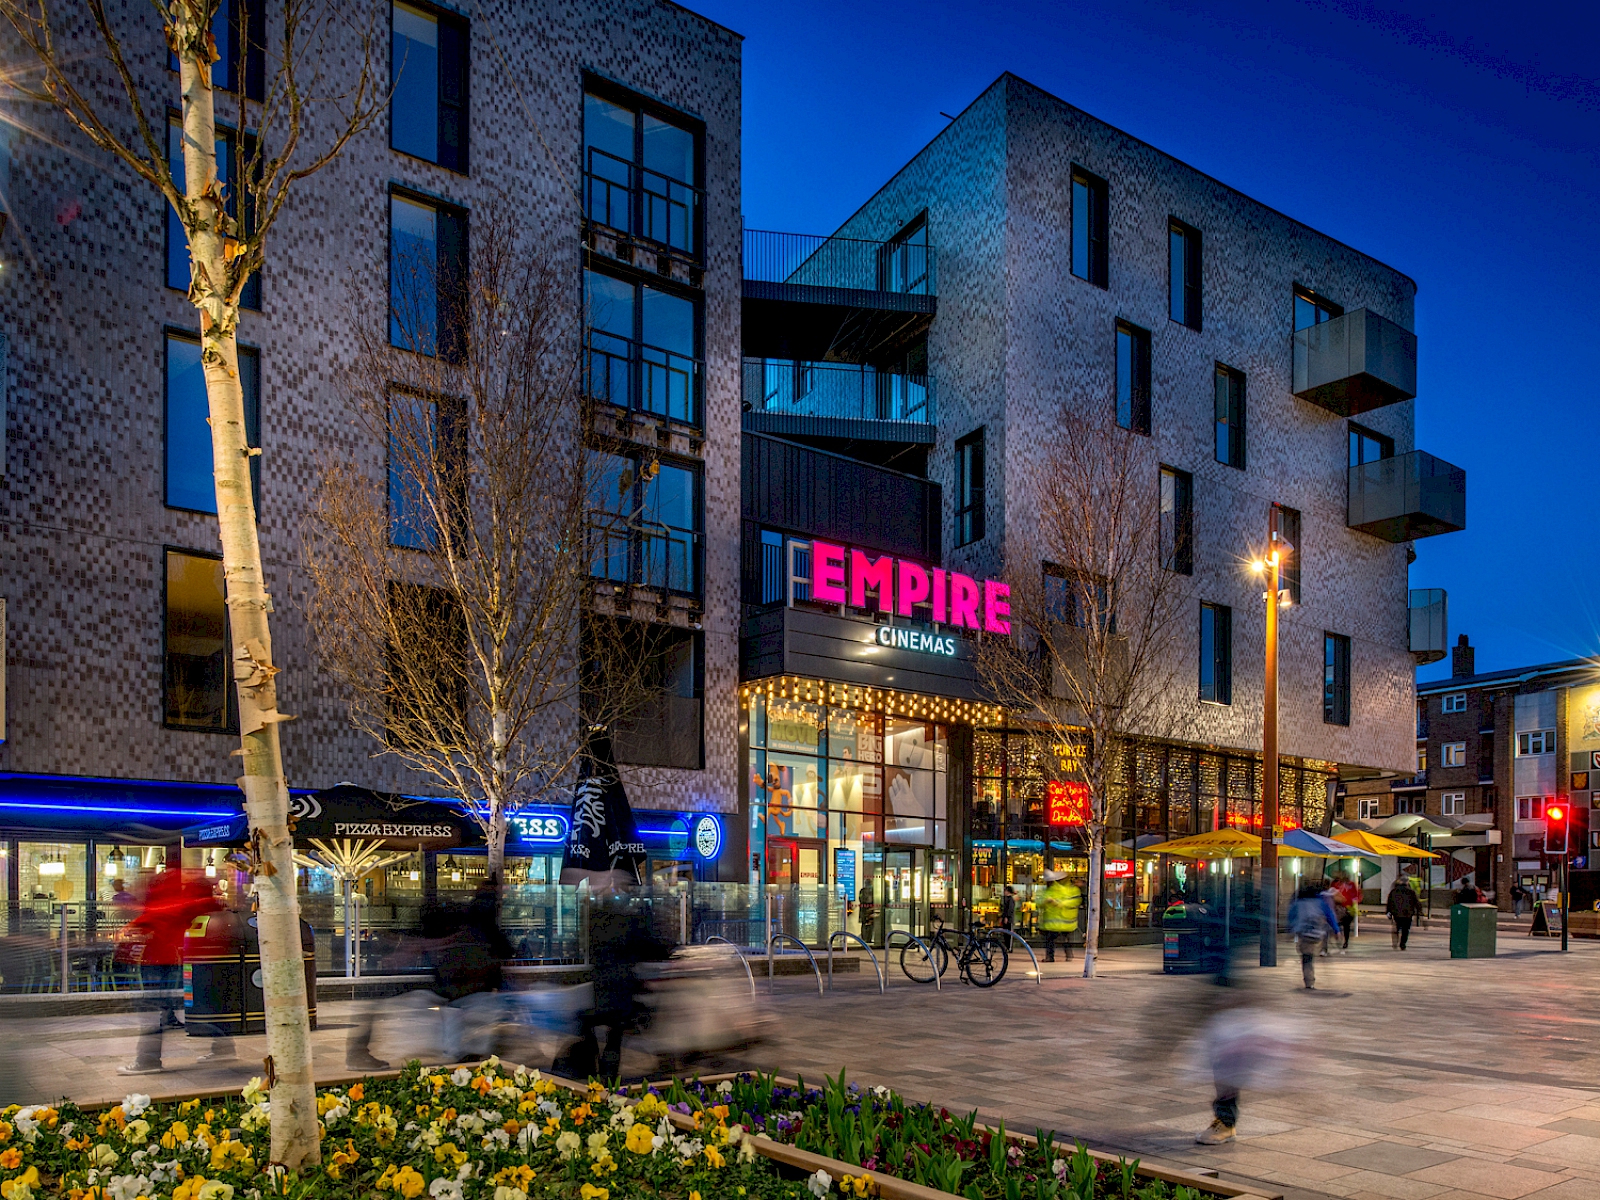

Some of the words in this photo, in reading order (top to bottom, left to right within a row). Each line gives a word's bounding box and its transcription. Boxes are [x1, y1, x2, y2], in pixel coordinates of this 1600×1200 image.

[812, 541, 1011, 635] EMPIRE
[879, 626, 955, 656] CINEMAS
[1052, 743, 1087, 757] TURTLE
[1060, 759, 1078, 773] BAY
